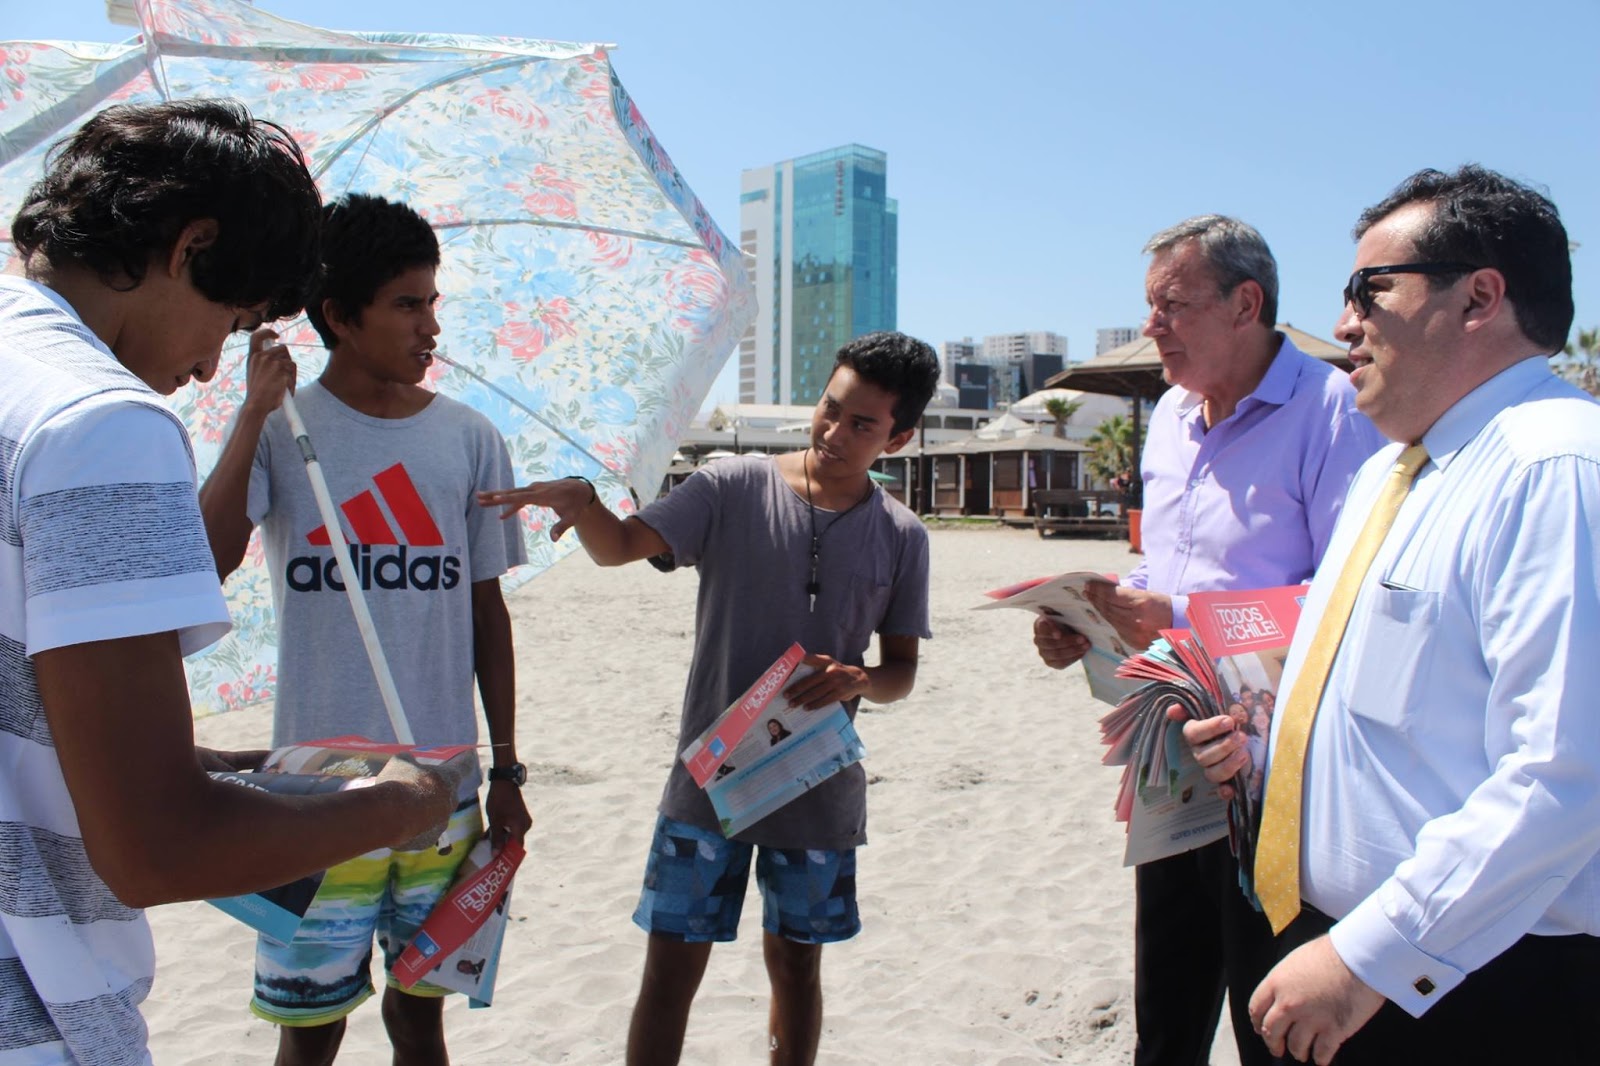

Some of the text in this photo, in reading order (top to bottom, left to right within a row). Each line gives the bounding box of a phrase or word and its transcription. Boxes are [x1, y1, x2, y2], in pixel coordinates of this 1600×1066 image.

[286, 544, 461, 592] adidas
[1216, 607, 1264, 625] TODOS
[472, 866, 511, 912] TODOS
